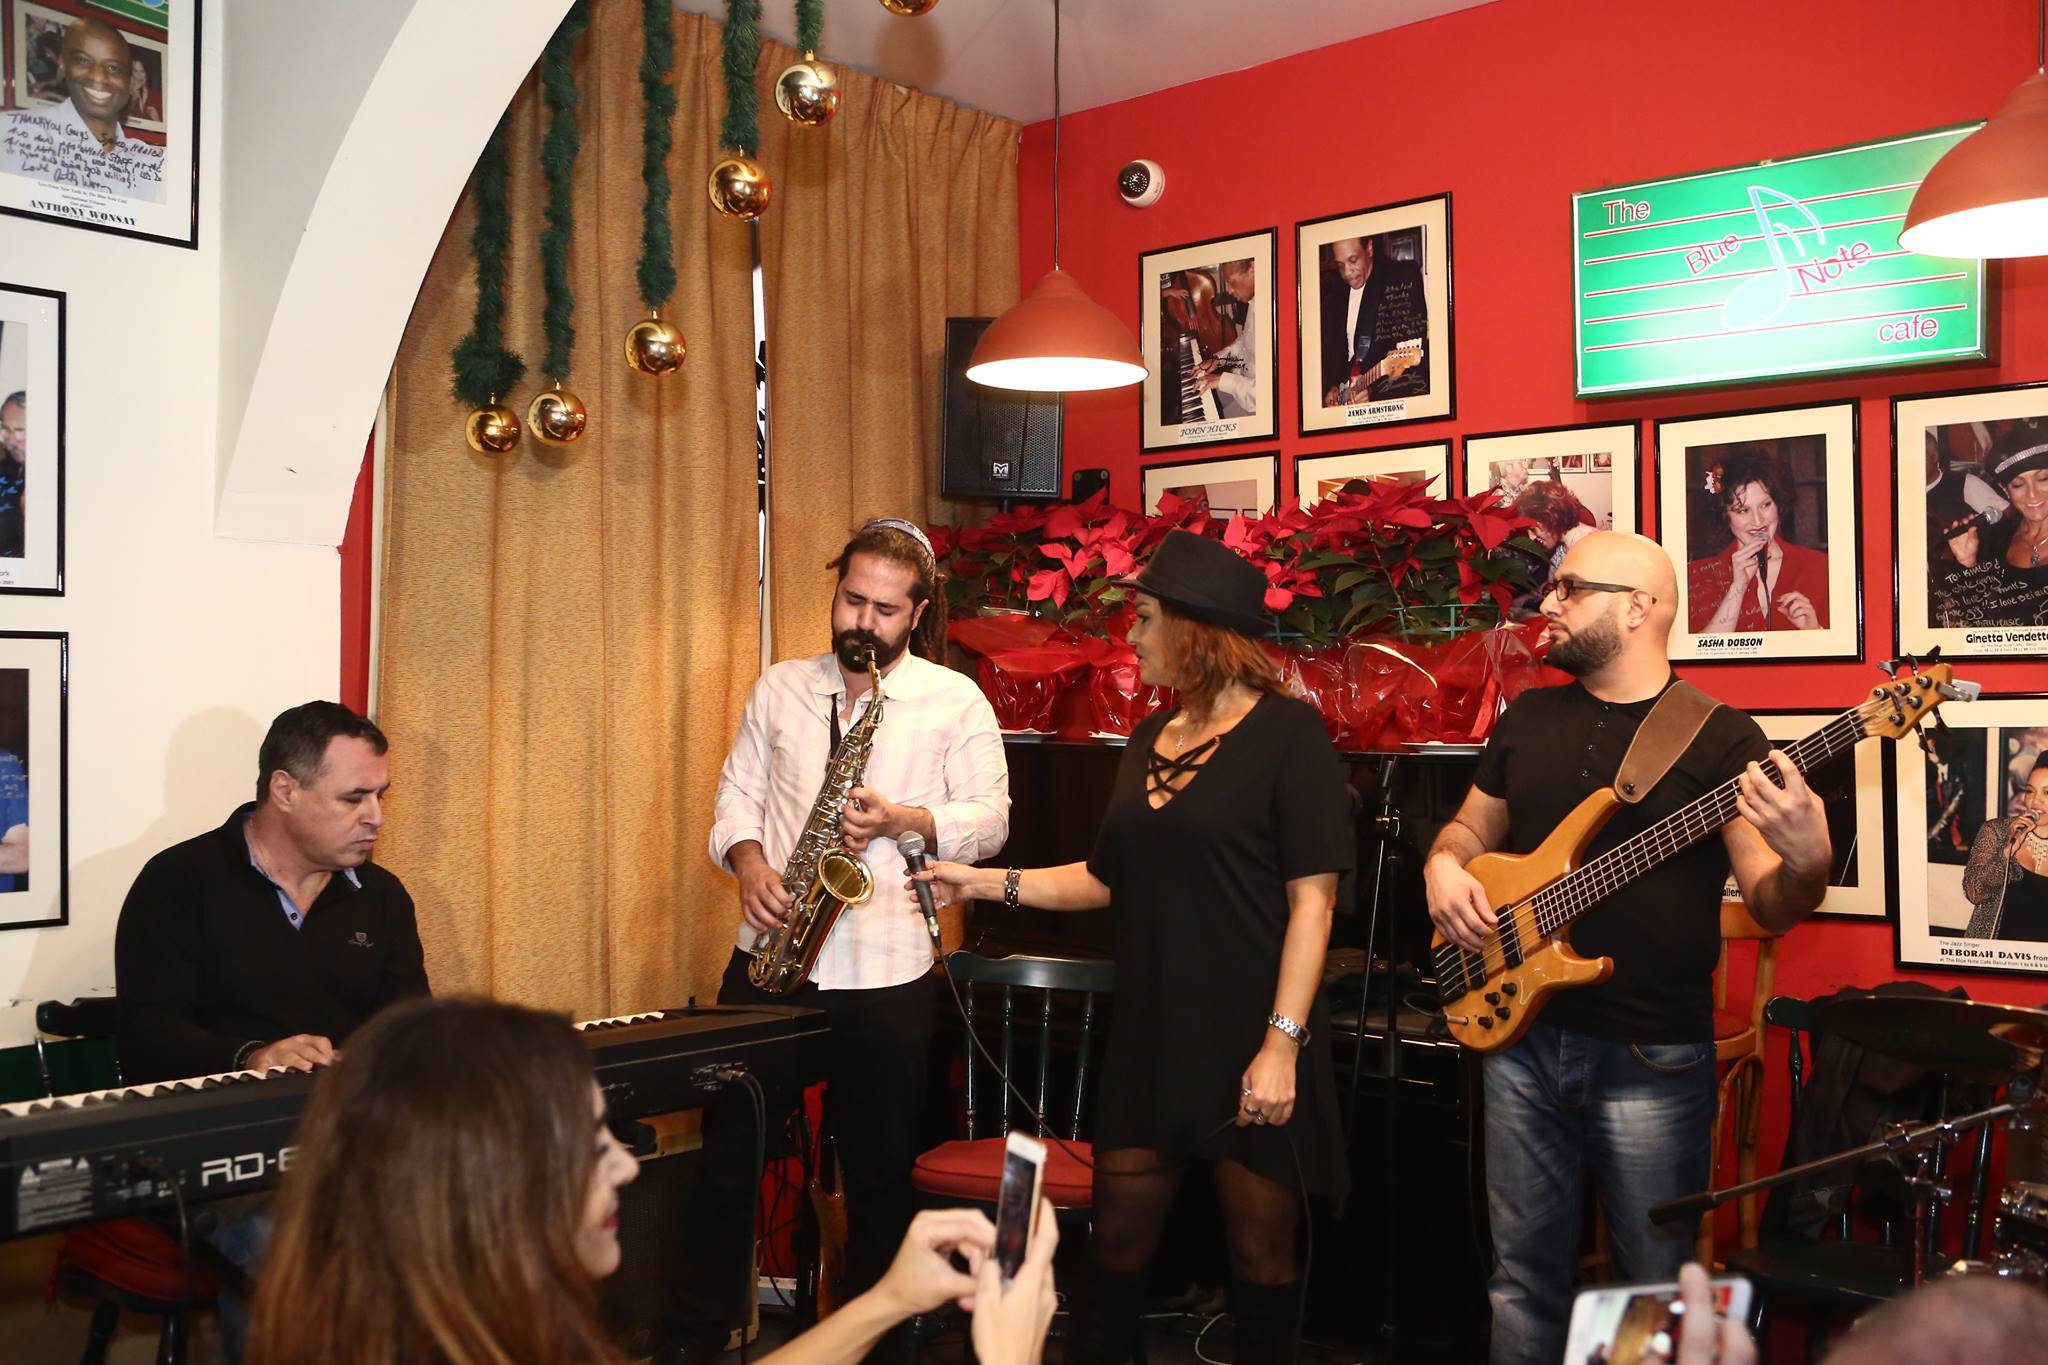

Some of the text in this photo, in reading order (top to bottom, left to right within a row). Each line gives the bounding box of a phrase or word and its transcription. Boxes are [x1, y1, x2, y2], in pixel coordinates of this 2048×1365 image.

[30, 200, 86, 217] ANTHONY
[89, 210, 137, 226] WONSAY
[1602, 199, 1651, 224] The
[1684, 234, 1872, 293] Blue Note
[1878, 313, 1939, 342] cafe
[1347, 408, 1367, 417] JAMES
[1368, 403, 1405, 415] ARMSTRONG
[1697, 638, 1763, 648] SASHA DOBSON
[1966, 633, 2003, 644] Ginetta
[1941, 948, 1994, 958] DEBORAH
[1998, 951, 2032, 960] DAVIS
